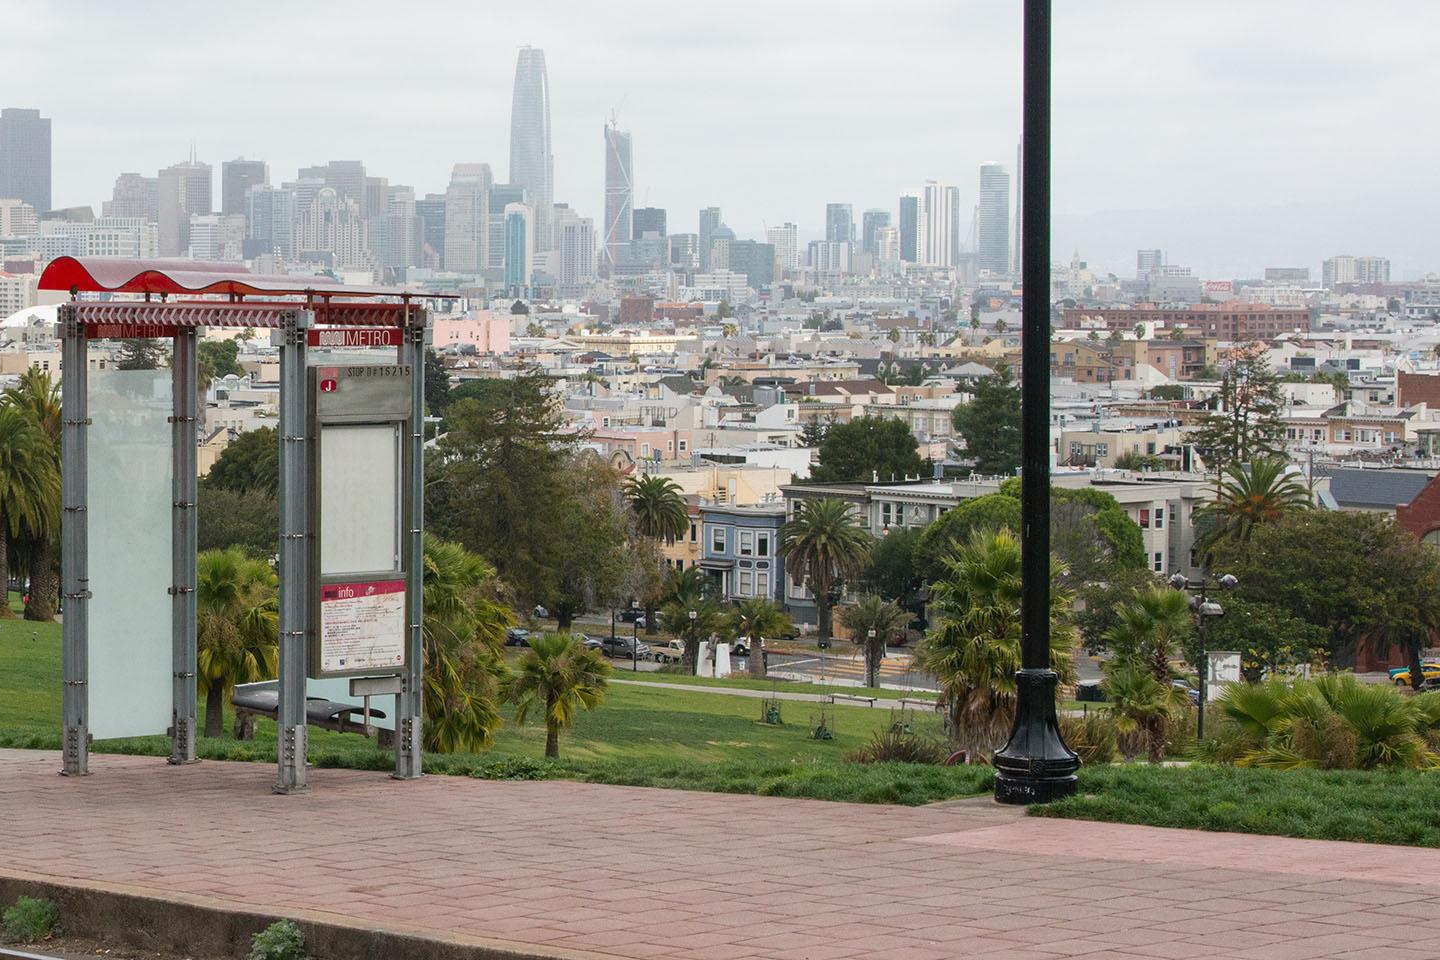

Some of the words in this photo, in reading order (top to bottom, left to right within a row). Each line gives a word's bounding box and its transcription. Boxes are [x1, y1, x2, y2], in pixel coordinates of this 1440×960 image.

[123, 324, 165, 338] METRO
[346, 330, 392, 346] METRO
[348, 367, 364, 377] STOP
[325, 380, 332, 392] J
[338, 586, 354, 598] info
